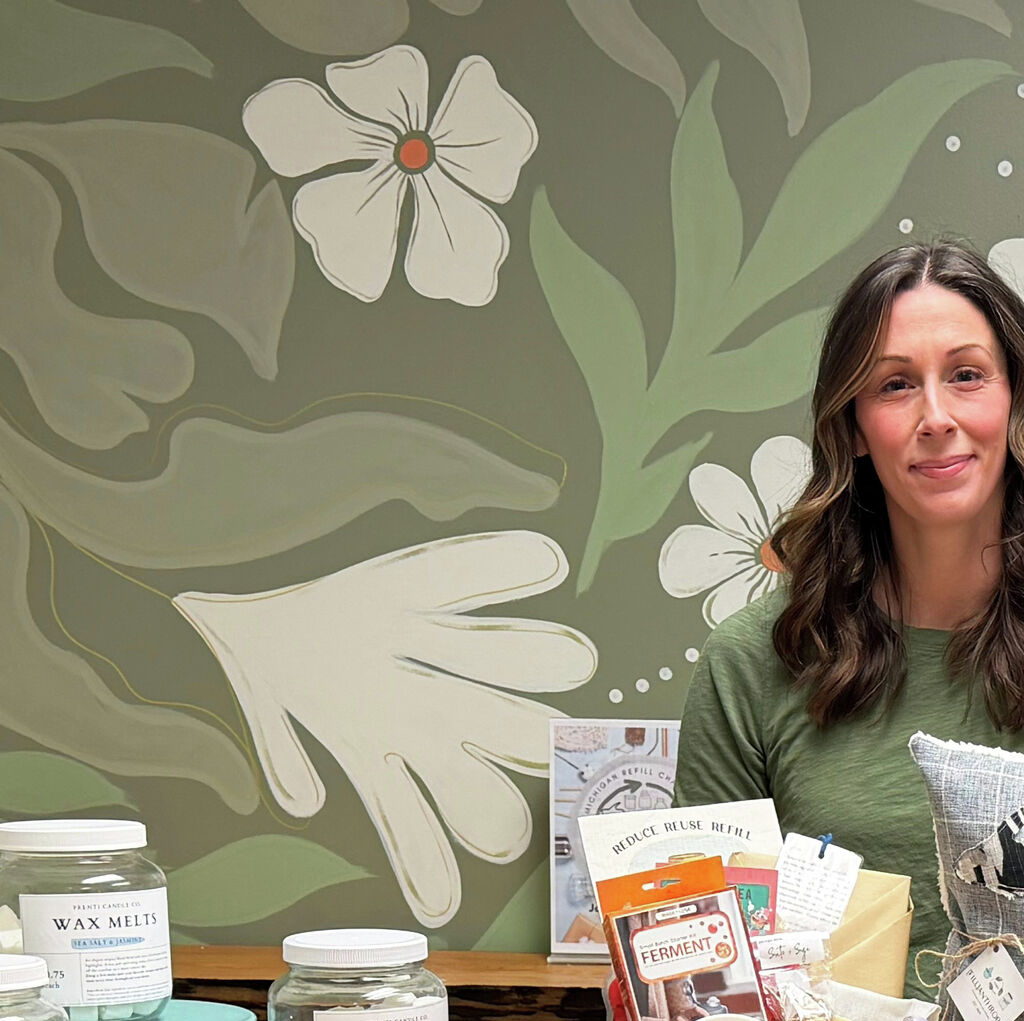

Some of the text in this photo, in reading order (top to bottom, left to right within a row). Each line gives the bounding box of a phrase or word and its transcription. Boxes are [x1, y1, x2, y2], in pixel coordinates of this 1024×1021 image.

[585, 773, 618, 816] MICHIGAN
[621, 767, 653, 776] REFILL
[612, 820, 752, 855] REDUCE REUSE REFILL
[102, 902, 129, 910] CANDLE
[52, 912, 158, 931] WAX MELTS
[641, 937, 712, 964] FERMENT
